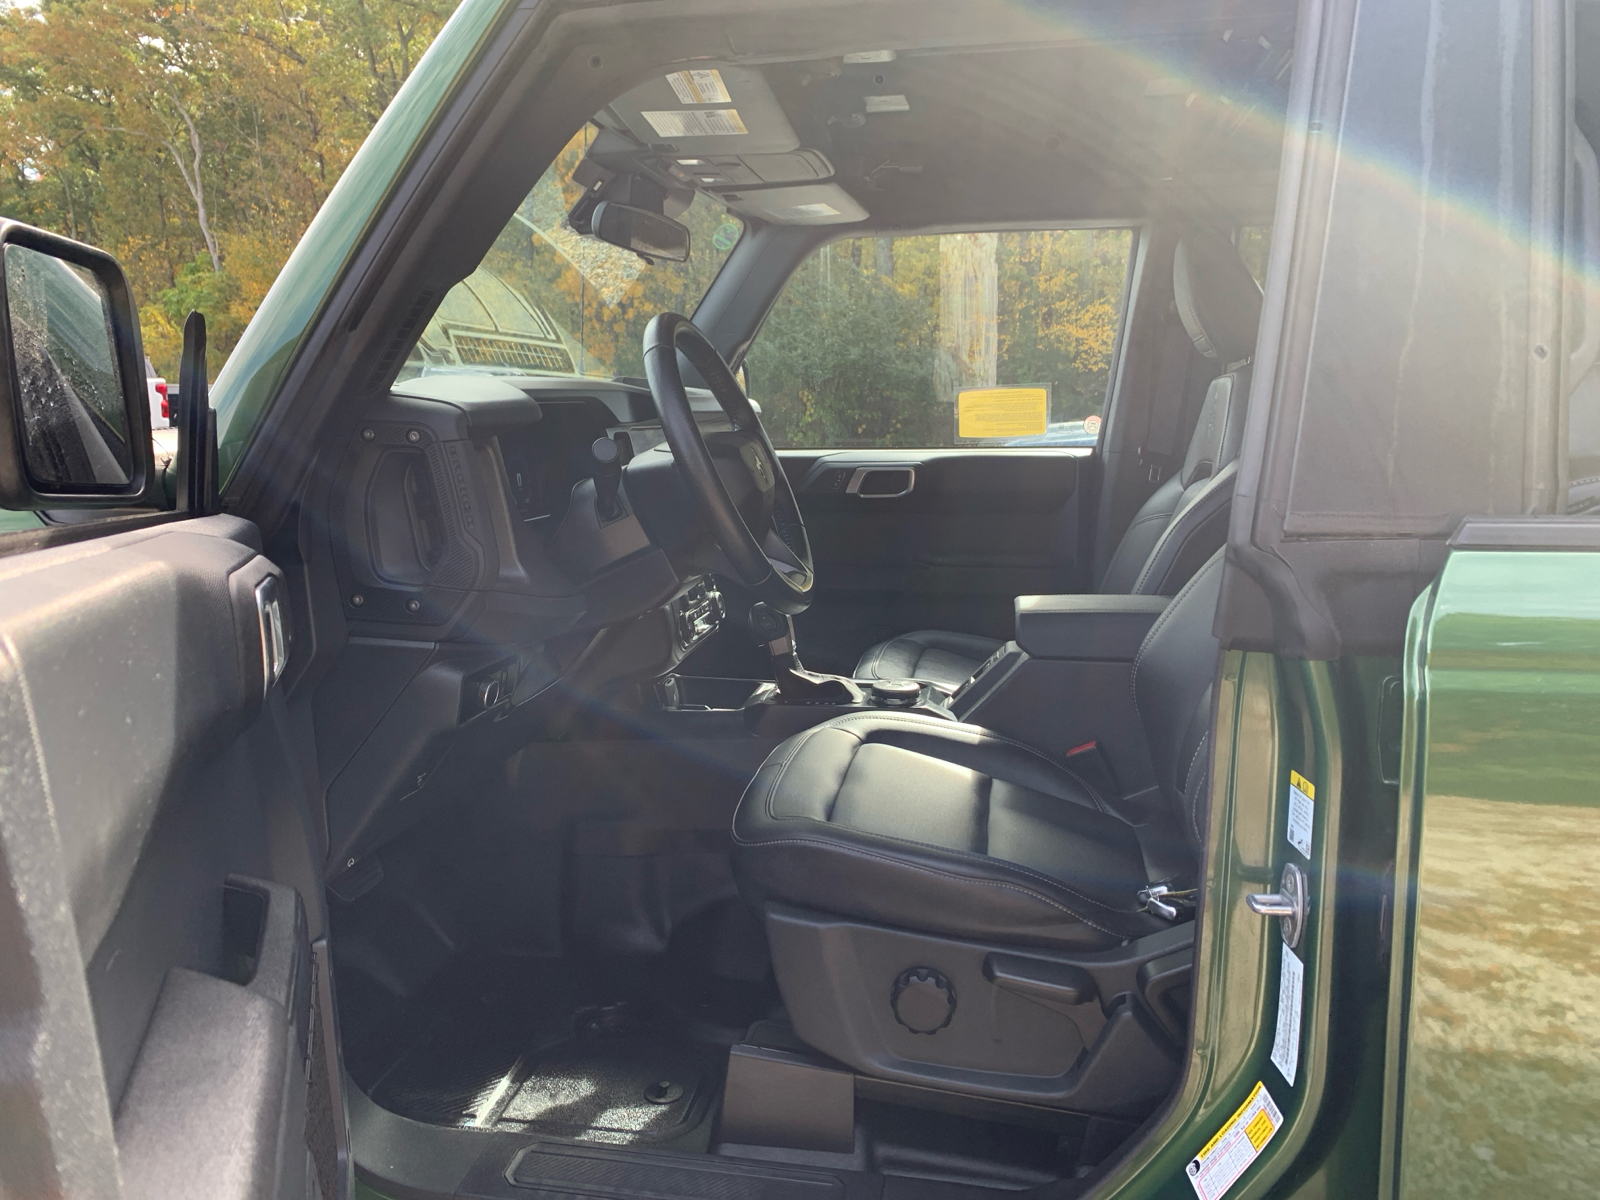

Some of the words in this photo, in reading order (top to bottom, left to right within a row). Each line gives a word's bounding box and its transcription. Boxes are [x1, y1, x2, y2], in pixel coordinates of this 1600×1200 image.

[1200, 1147, 1210, 1158] TIRE
[1210, 1137, 1219, 1147] AND
[1219, 1118, 1237, 1137] LOADING
[1236, 1085, 1262, 1118] INFORMATION
